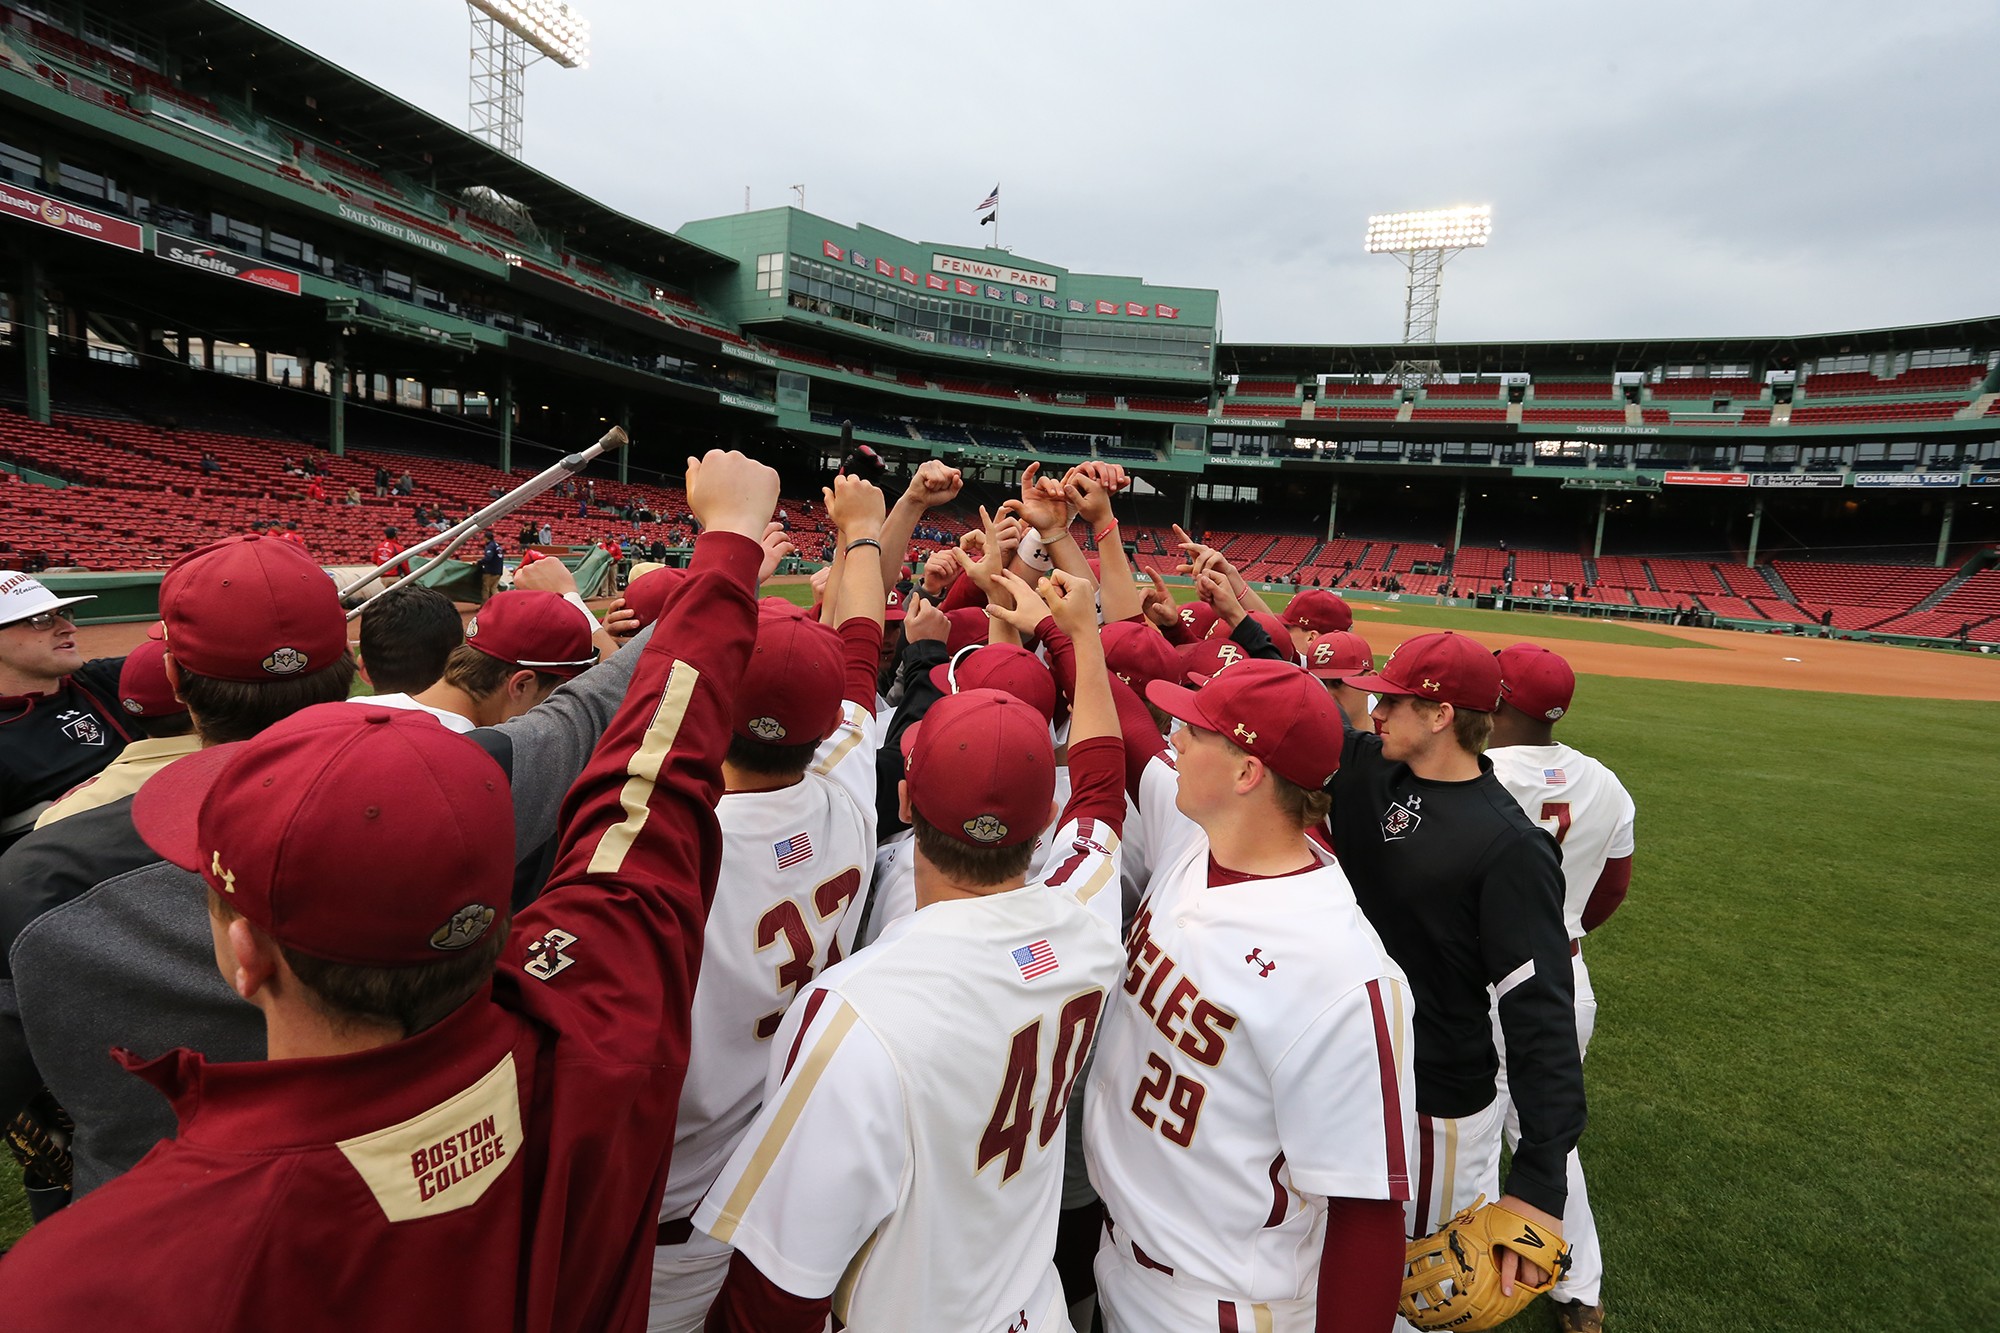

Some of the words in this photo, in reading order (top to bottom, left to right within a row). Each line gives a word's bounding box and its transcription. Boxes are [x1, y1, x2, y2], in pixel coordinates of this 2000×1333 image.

[67, 211, 103, 232] Nine
[339, 204, 368, 226] STATE
[370, 216, 405, 238] STREET
[406, 228, 448, 254] PAVILION
[169, 247, 237, 275] Safelite
[941, 259, 1002, 279] FENWAY
[1010, 271, 1048, 288] PARK
[248, 272, 290, 290] AutoGlass
[1857, 474, 1921, 483] COLUMBIA
[1922, 474, 1956, 483] TECH
[1313, 643, 1335, 665] BC
[1539, 800, 1573, 845] 7
[974, 985, 1106, 1190] 40
[1131, 1049, 1207, 1149] 29
[410, 1114, 496, 1179] BOSTON
[417, 1134, 506, 1202] COLLEGE
